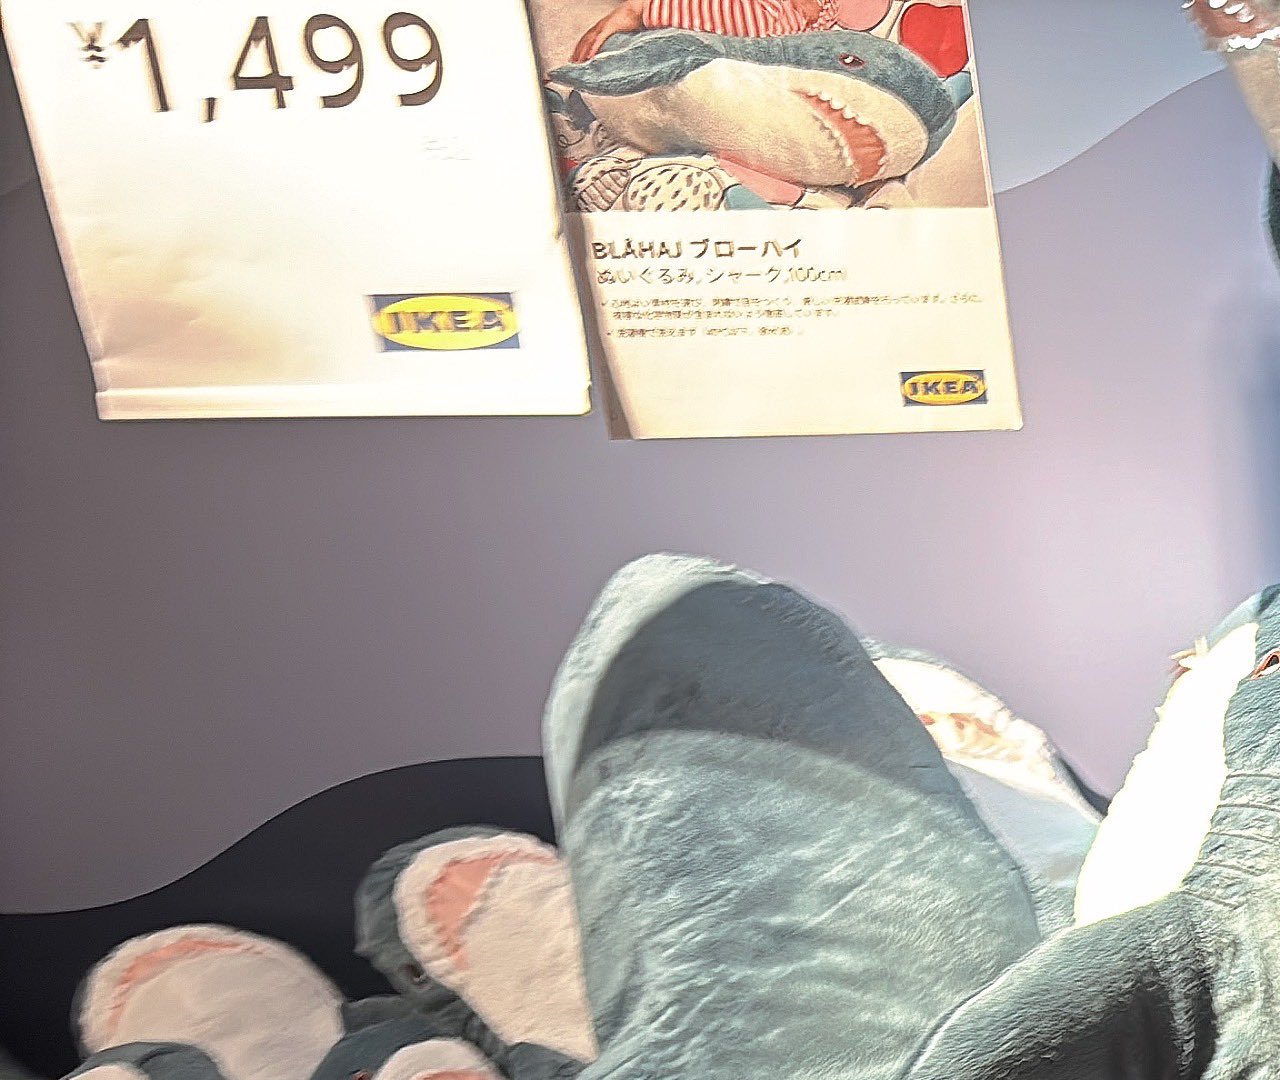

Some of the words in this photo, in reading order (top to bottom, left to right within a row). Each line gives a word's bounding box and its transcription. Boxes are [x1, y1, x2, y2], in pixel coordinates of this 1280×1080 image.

[592, 238, 683, 259] BLÅHAJ
[690, 238, 802, 259] ブローハイ
[391, 310, 505, 334] IKEA
[909, 380, 978, 395] IKEA
